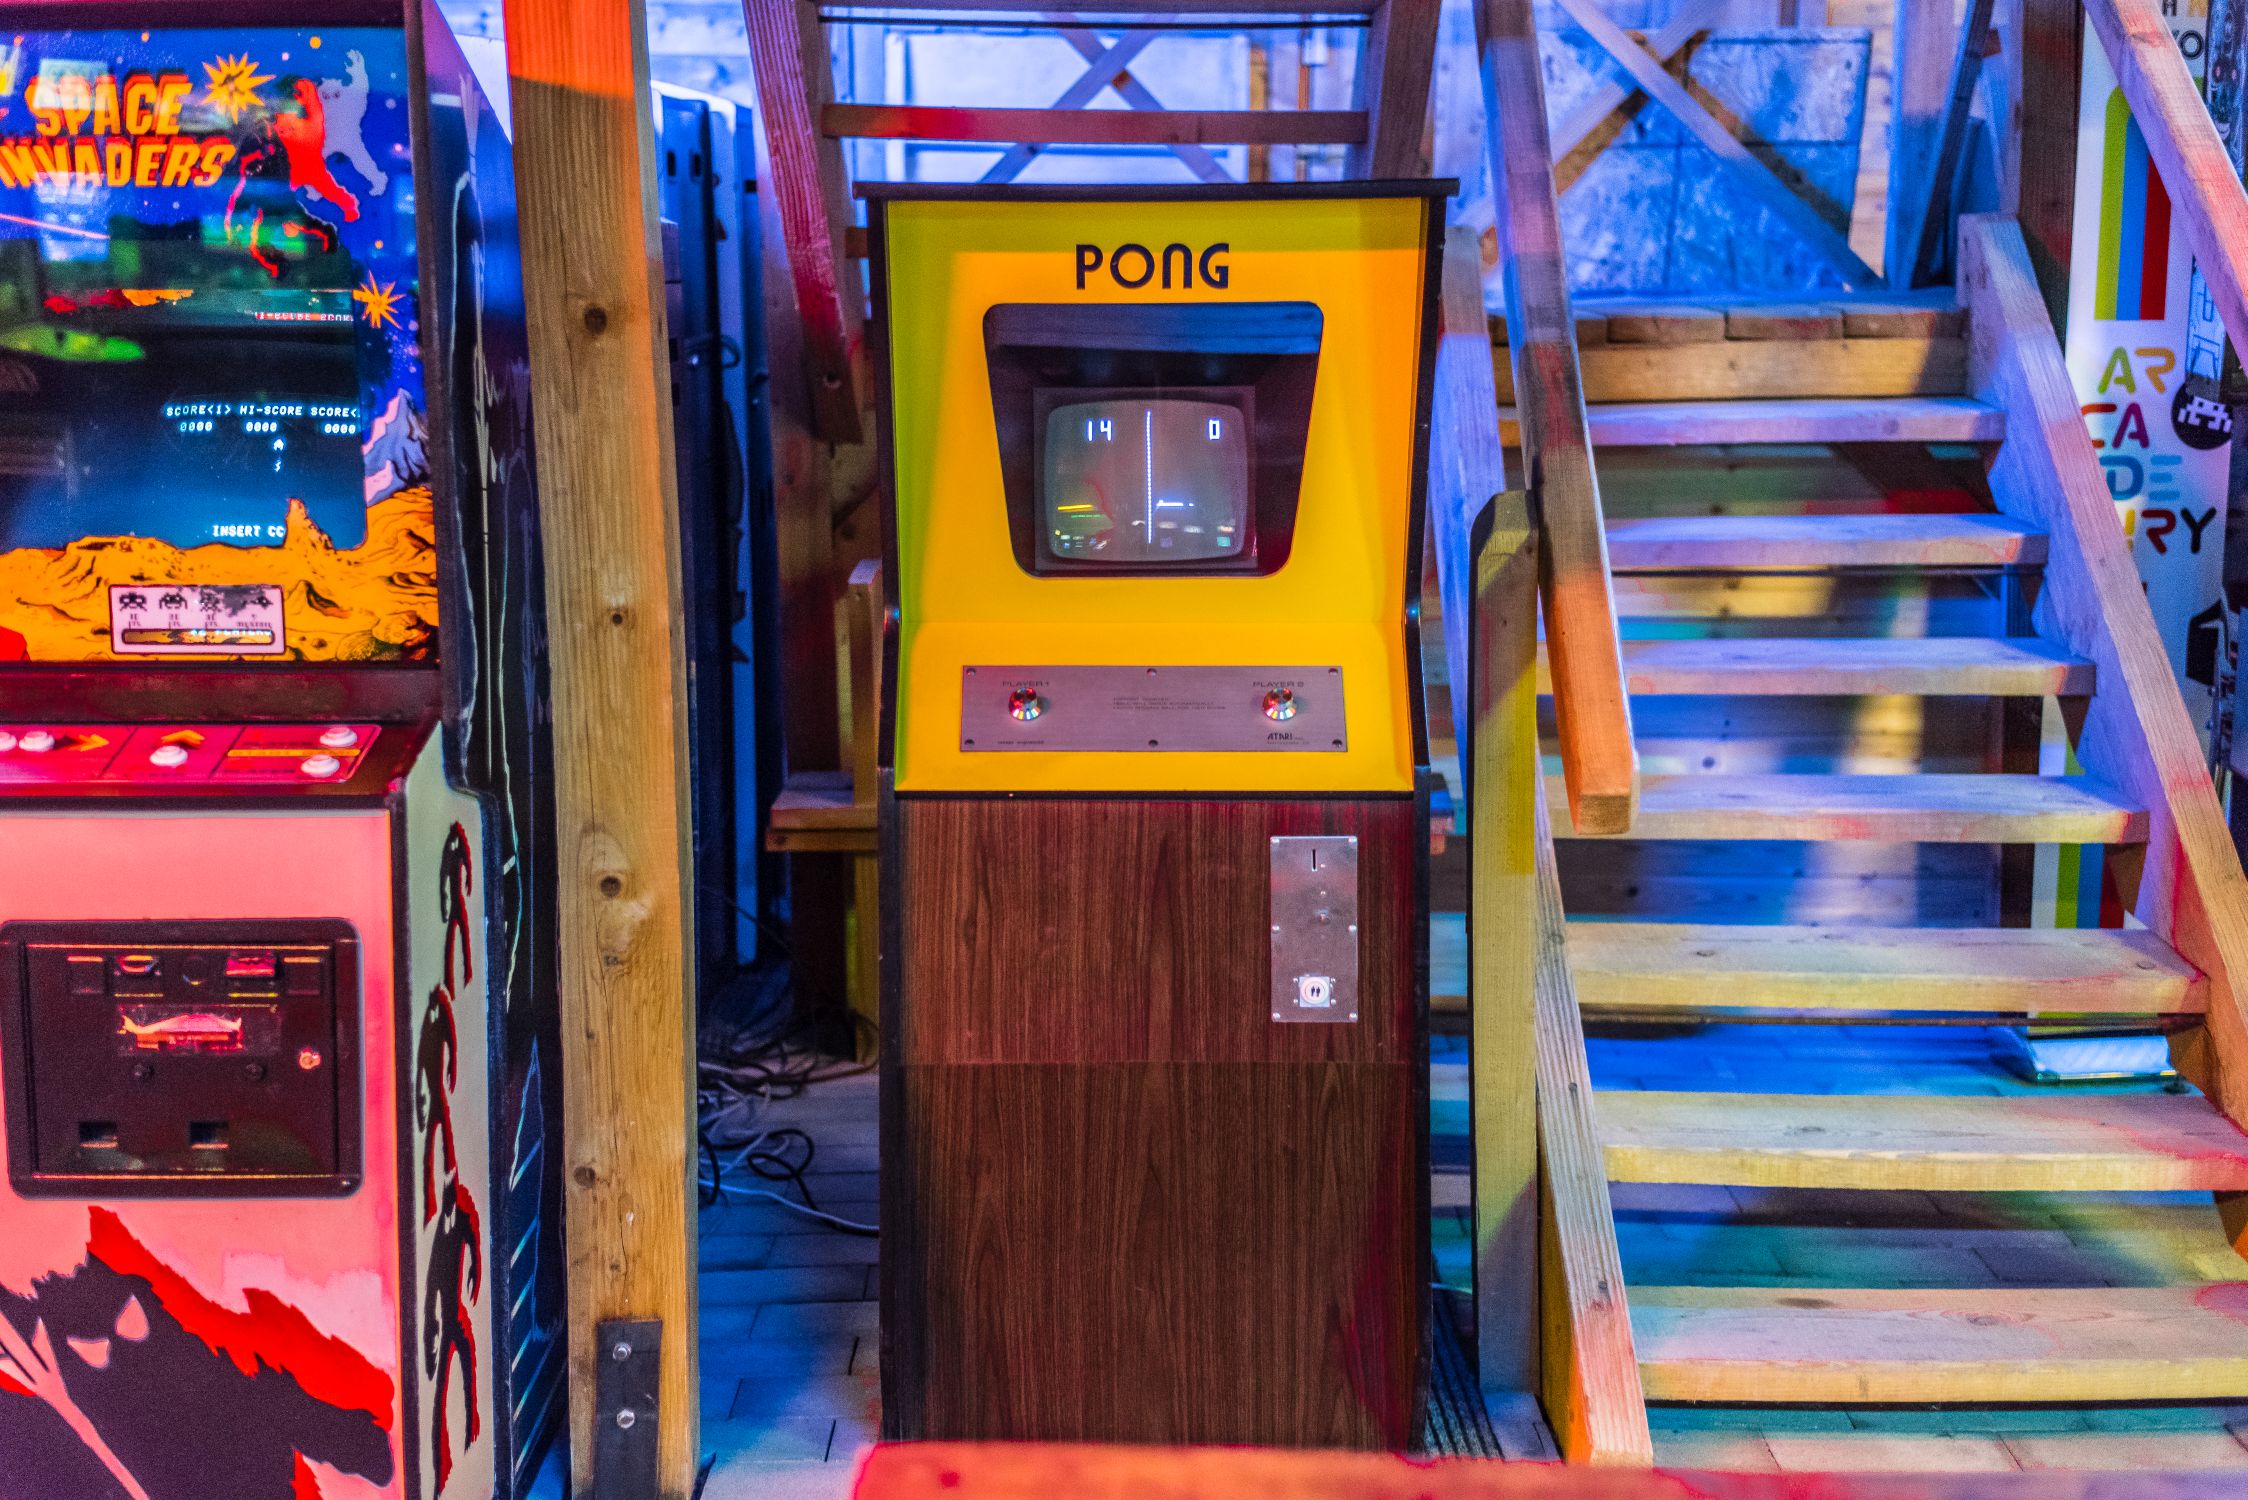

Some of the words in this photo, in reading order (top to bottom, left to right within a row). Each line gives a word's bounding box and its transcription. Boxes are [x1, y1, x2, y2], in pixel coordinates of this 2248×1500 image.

[24, 74, 193, 136] SPACE
[0, 137, 236, 188] INVADERS
[1076, 243, 1229, 290] PONG
[2098, 347, 2176, 394] AR
[166, 404, 231, 417] SCORE<1>
[240, 405, 303, 416] HI-SCORE
[311, 406, 361, 418] SCORE<
[180, 421, 213, 433] 0000
[246, 421, 278, 432] 0000
[324, 423, 356, 434] 0000
[1088, 419, 1112, 441] 14
[1209, 419, 1220, 440] 0
[2100, 455, 2182, 501] DE
[213, 525, 261, 537] INSERT
[1267, 732, 1293, 741] ATARI
